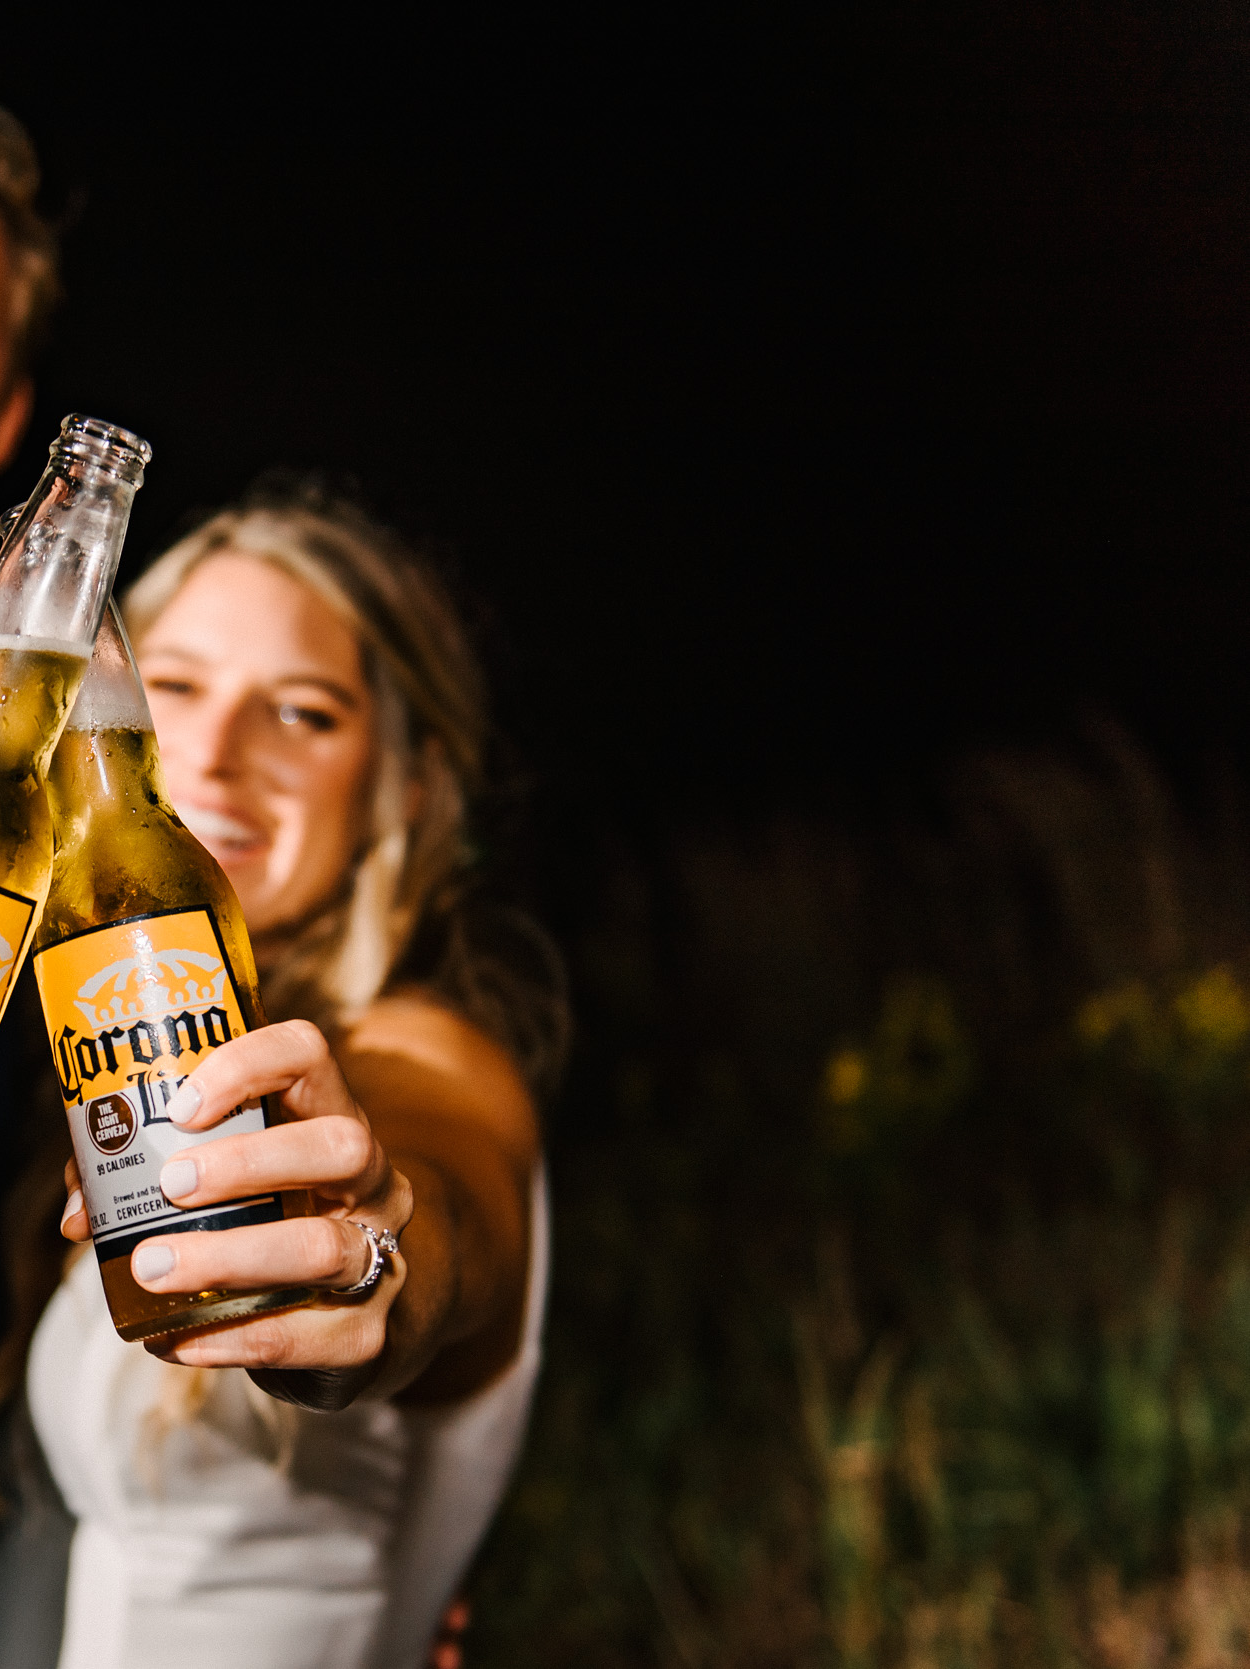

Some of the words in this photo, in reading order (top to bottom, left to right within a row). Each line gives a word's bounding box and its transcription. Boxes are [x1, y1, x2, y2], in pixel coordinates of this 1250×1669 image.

[52, 1005, 233, 1106] Corona
[97, 1101, 114, 1116] THE
[97, 1112, 120, 1129] LIGHT
[95, 1123, 130, 1143] CERVEZA
[96, 1163, 106, 1176] 99
[106, 1152, 146, 1173] CALORIES
[113, 1191, 135, 1204] Brewed
[136, 1187, 149, 1198] and
